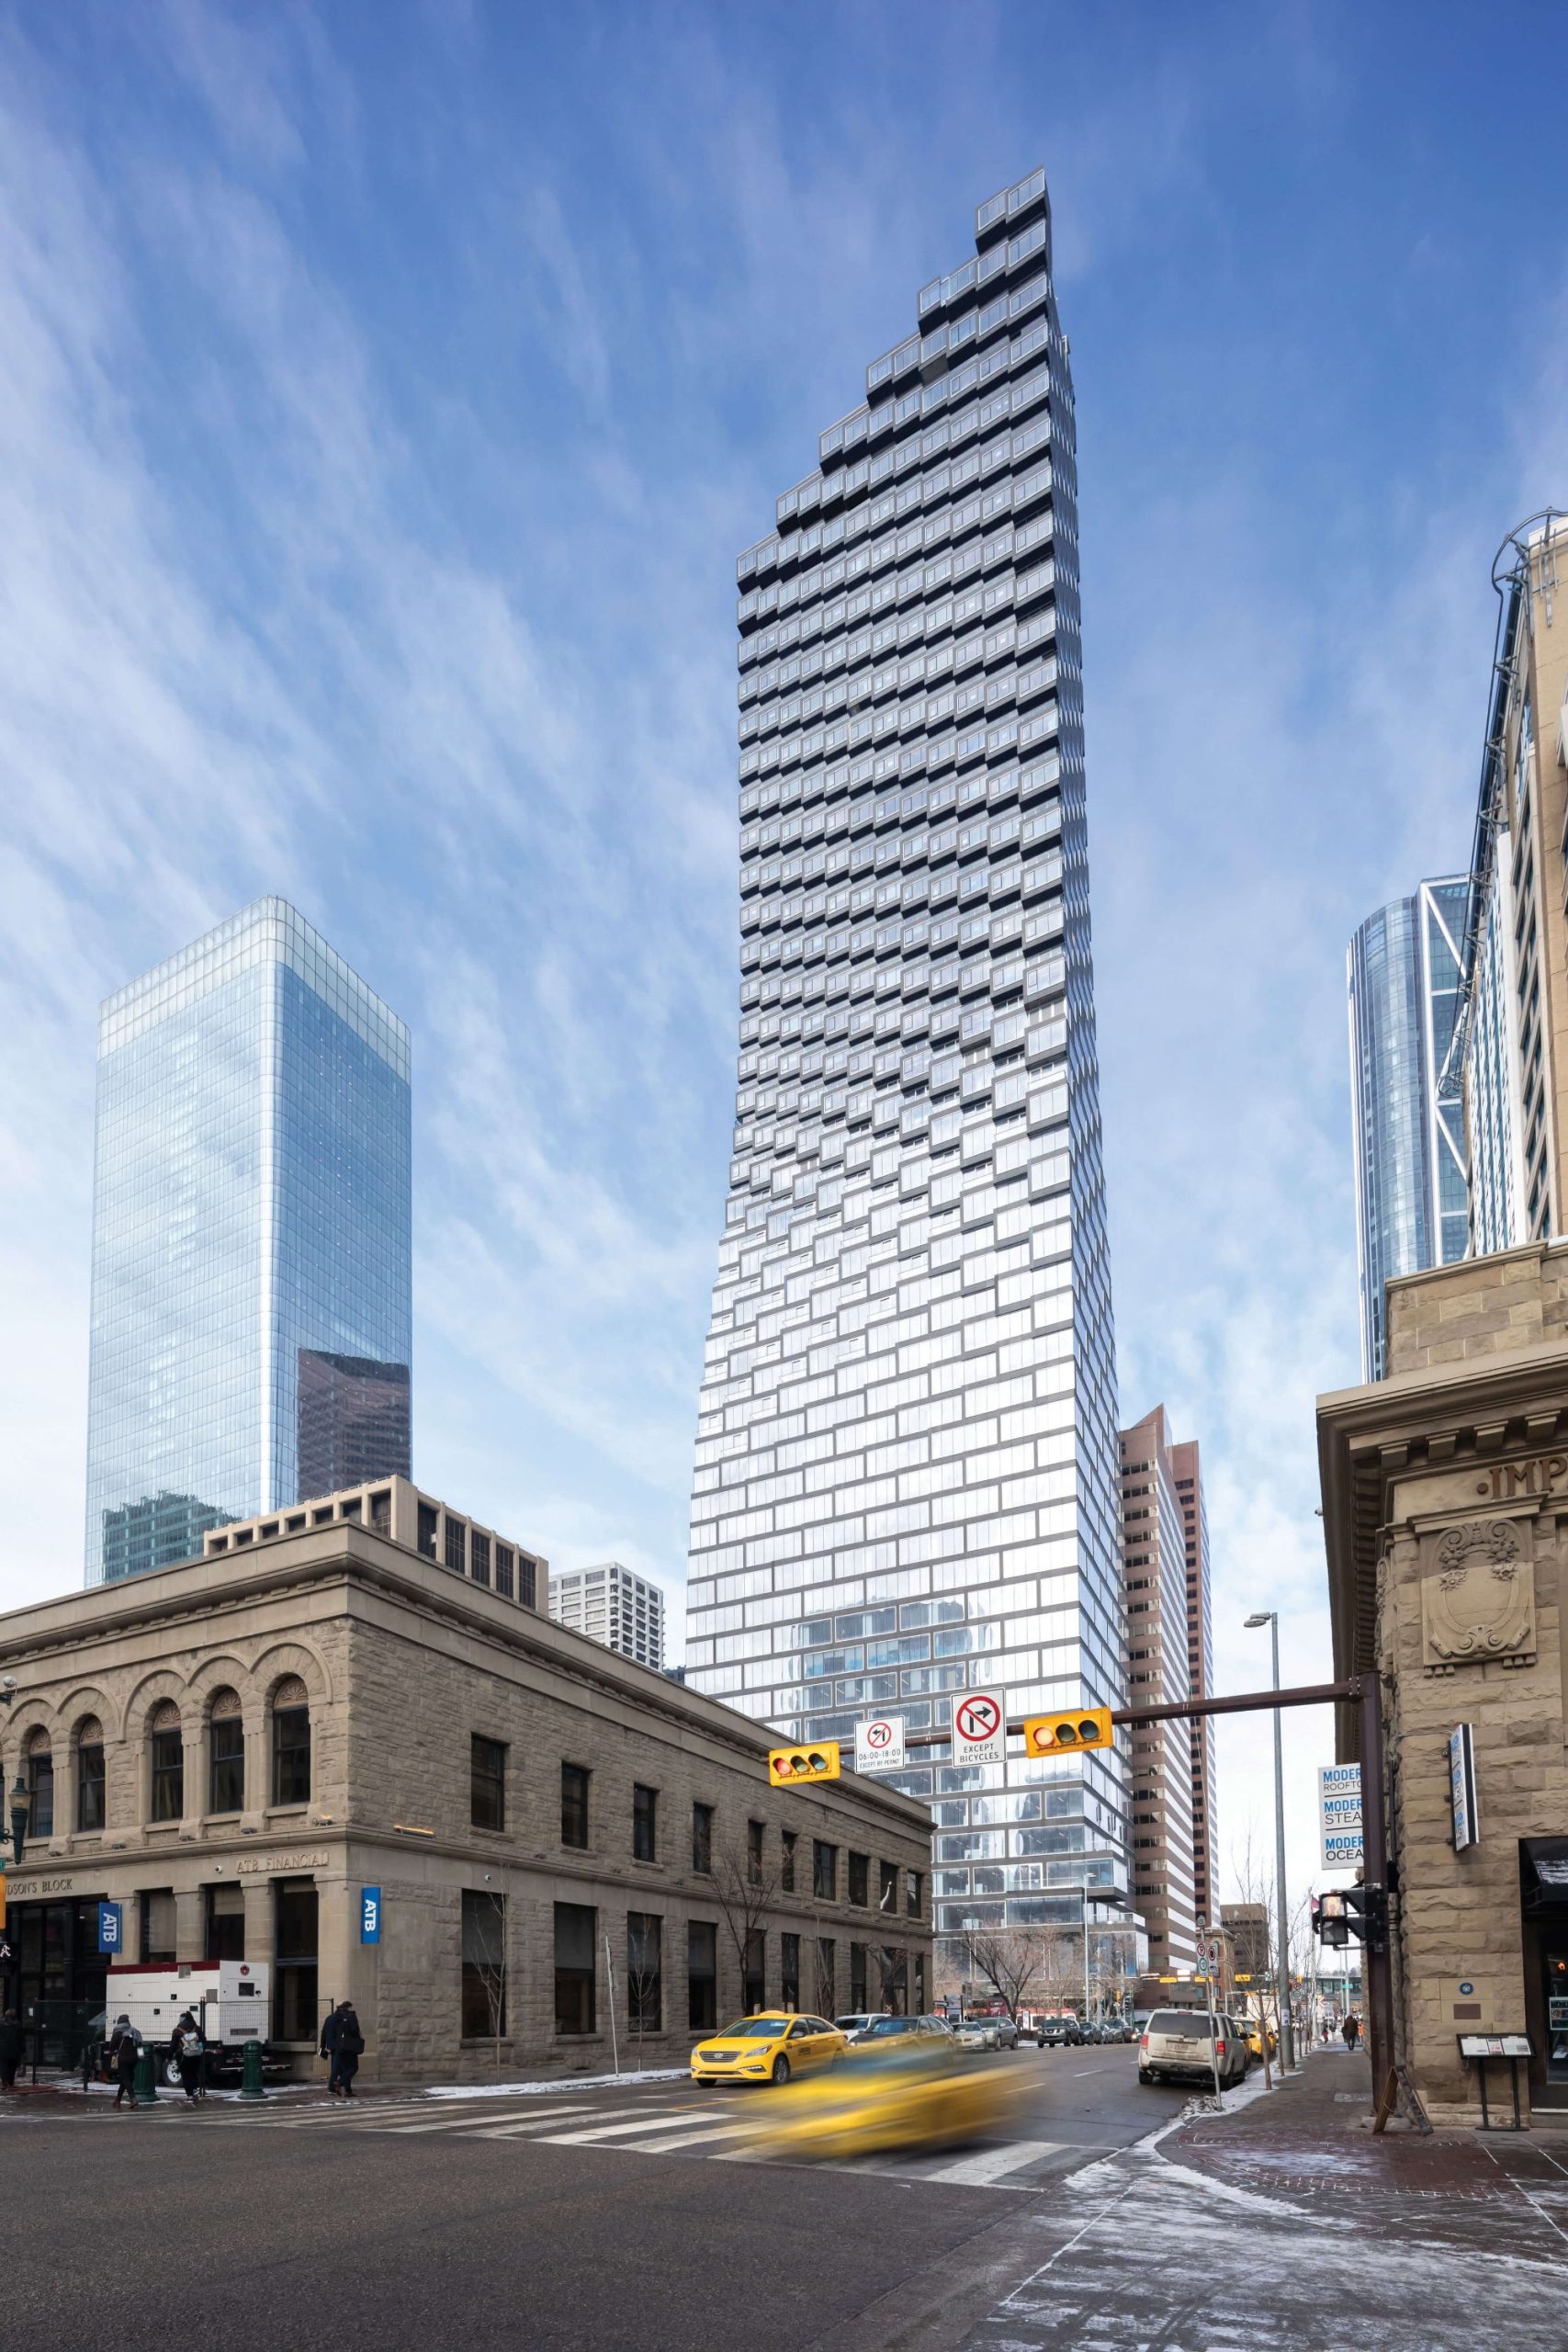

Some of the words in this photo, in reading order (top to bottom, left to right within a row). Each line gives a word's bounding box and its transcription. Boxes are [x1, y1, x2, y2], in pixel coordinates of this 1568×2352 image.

[1489, 1456, 1568, 1500] IMP
[858, 1748, 901, 1761] 06:00-18:00
[964, 1743, 995, 1754] EXCEPT
[959, 1752, 999, 1763] BICYCLES
[1323, 1768, 1362, 1783] MODER
[1324, 1781, 1362, 1792] ROOFTO
[1324, 1799, 1362, 1814] MODER
[1325, 1811, 1363, 1825] STEA
[1325, 1836, 1364, 1850] MODER
[237, 1859, 259, 1873] ATB
[265, 1851, 330, 1871] FINANCIAL
[1325, 1849, 1364, 1861] OCEA
[6, 1882, 38, 1895] DSON'S
[41, 1878, 73, 1893] BLOCK
[365, 1899, 377, 1932] ATB
[103, 1912, 118, 1942] ATB
